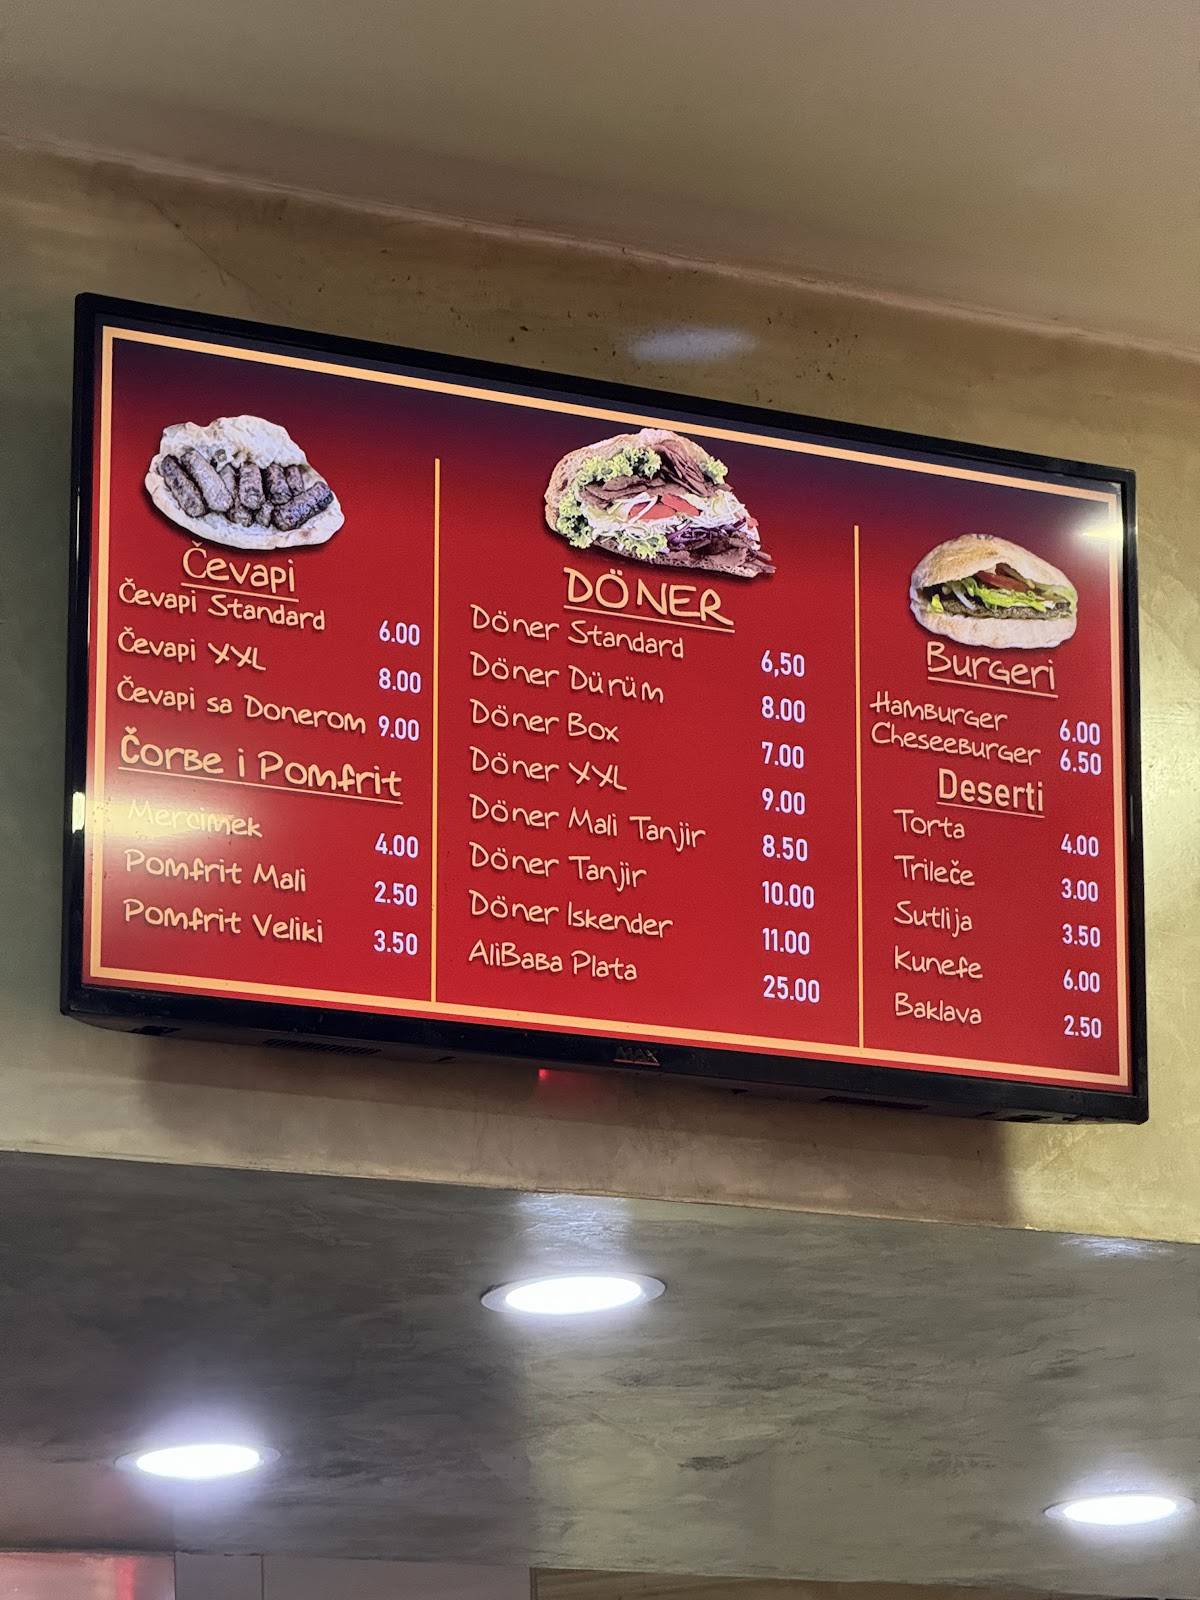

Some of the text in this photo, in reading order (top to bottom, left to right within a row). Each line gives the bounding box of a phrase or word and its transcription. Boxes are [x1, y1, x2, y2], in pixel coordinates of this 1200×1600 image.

[182, 541, 295, 592] Čevapi
[118, 577, 325, 631] Čevapi Standard
[563, 567, 734, 626] DÖNER
[379, 620, 420, 646] 6.00
[470, 604, 684, 658] Döner Standard
[117, 627, 266, 671] Čevapi XXL
[761, 650, 805, 678] 6,50
[378, 668, 421, 694] 8.00
[470, 651, 664, 703] Döner Dürüm
[117, 675, 366, 734] Čevapi sa Donerom
[761, 696, 806, 723] 8.00
[378, 715, 420, 741] 9.00
[469, 698, 620, 742] Döner Box
[1059, 719, 1100, 745] 6.00
[469, 746, 627, 791] Döner XXL
[761, 742, 804, 768] 7.00
[1060, 750, 1102, 775] 6.50
[238, 748, 245, 777] i
[257, 751, 402, 797] Pomfrit
[762, 788, 806, 815] 9.00
[938, 768, 1043, 811] Deserti
[127, 800, 263, 838] Mercimek
[469, 793, 706, 852] Döner Mali Tanjir
[893, 809, 965, 839] Torta
[374, 833, 419, 858] 4.00
[762, 834, 808, 862] 8.50
[1061, 834, 1099, 857] 4.00
[123, 849, 306, 892] Pomfrit Mali
[469, 842, 647, 892] Döner Tanjir
[894, 855, 975, 886] Trileče
[374, 881, 418, 907] 2.50
[762, 881, 815, 909] 10.00
[1061, 878, 1099, 902] 3.00
[123, 899, 323, 943] Pomfrit Veliki
[469, 889, 673, 938] Döner Iskender
[894, 901, 972, 938] Sutlija
[373, 930, 418, 955] 3.50
[762, 928, 810, 955] 11.00
[1062, 923, 1100, 947] 3.50
[571, 950, 638, 981] Plata
[894, 945, 983, 979] Kunefe
[763, 975, 820, 1003] 25.00
[1063, 969, 1100, 992] 6.00
[895, 992, 982, 1025] Baklava
[1064, 1015, 1102, 1039] 2.50
